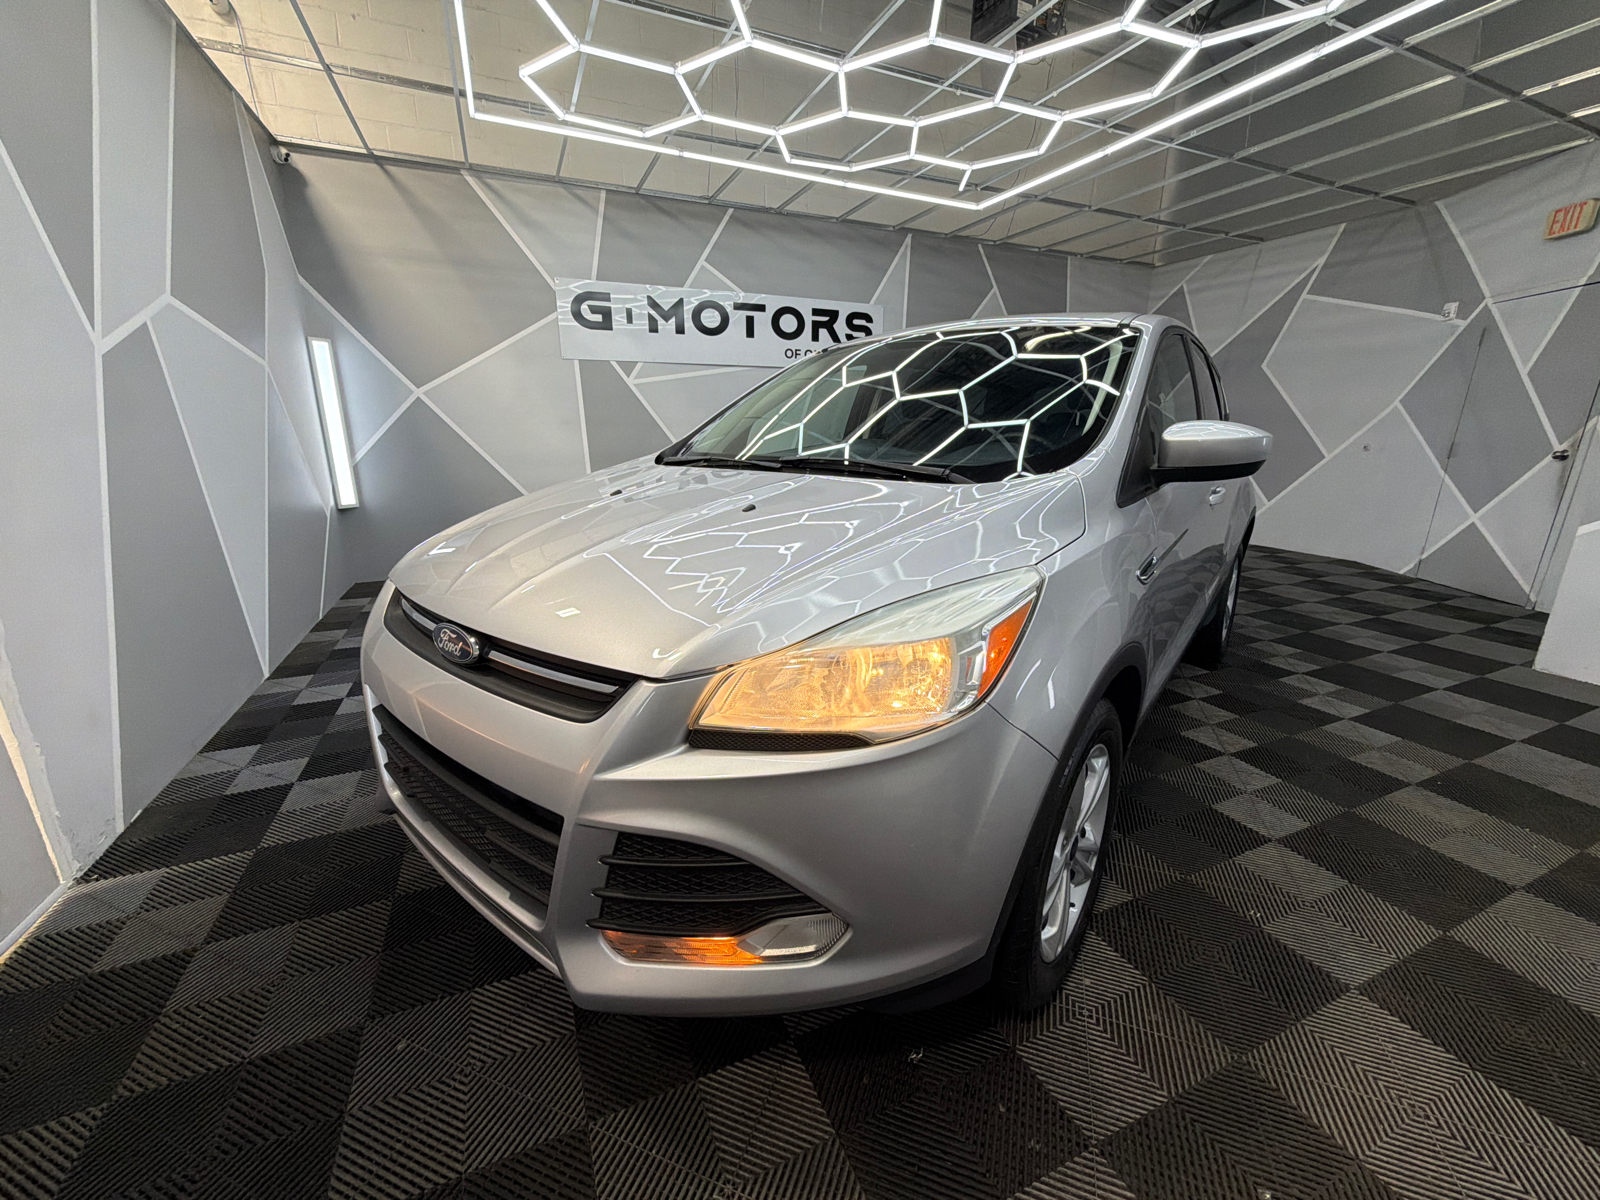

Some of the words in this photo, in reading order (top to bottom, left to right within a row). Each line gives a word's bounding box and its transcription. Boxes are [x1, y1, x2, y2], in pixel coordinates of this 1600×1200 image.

[1548, 201, 1588, 236] EXIT
[784, 348, 802, 359] OF
[438, 628, 462, 656] Ford
